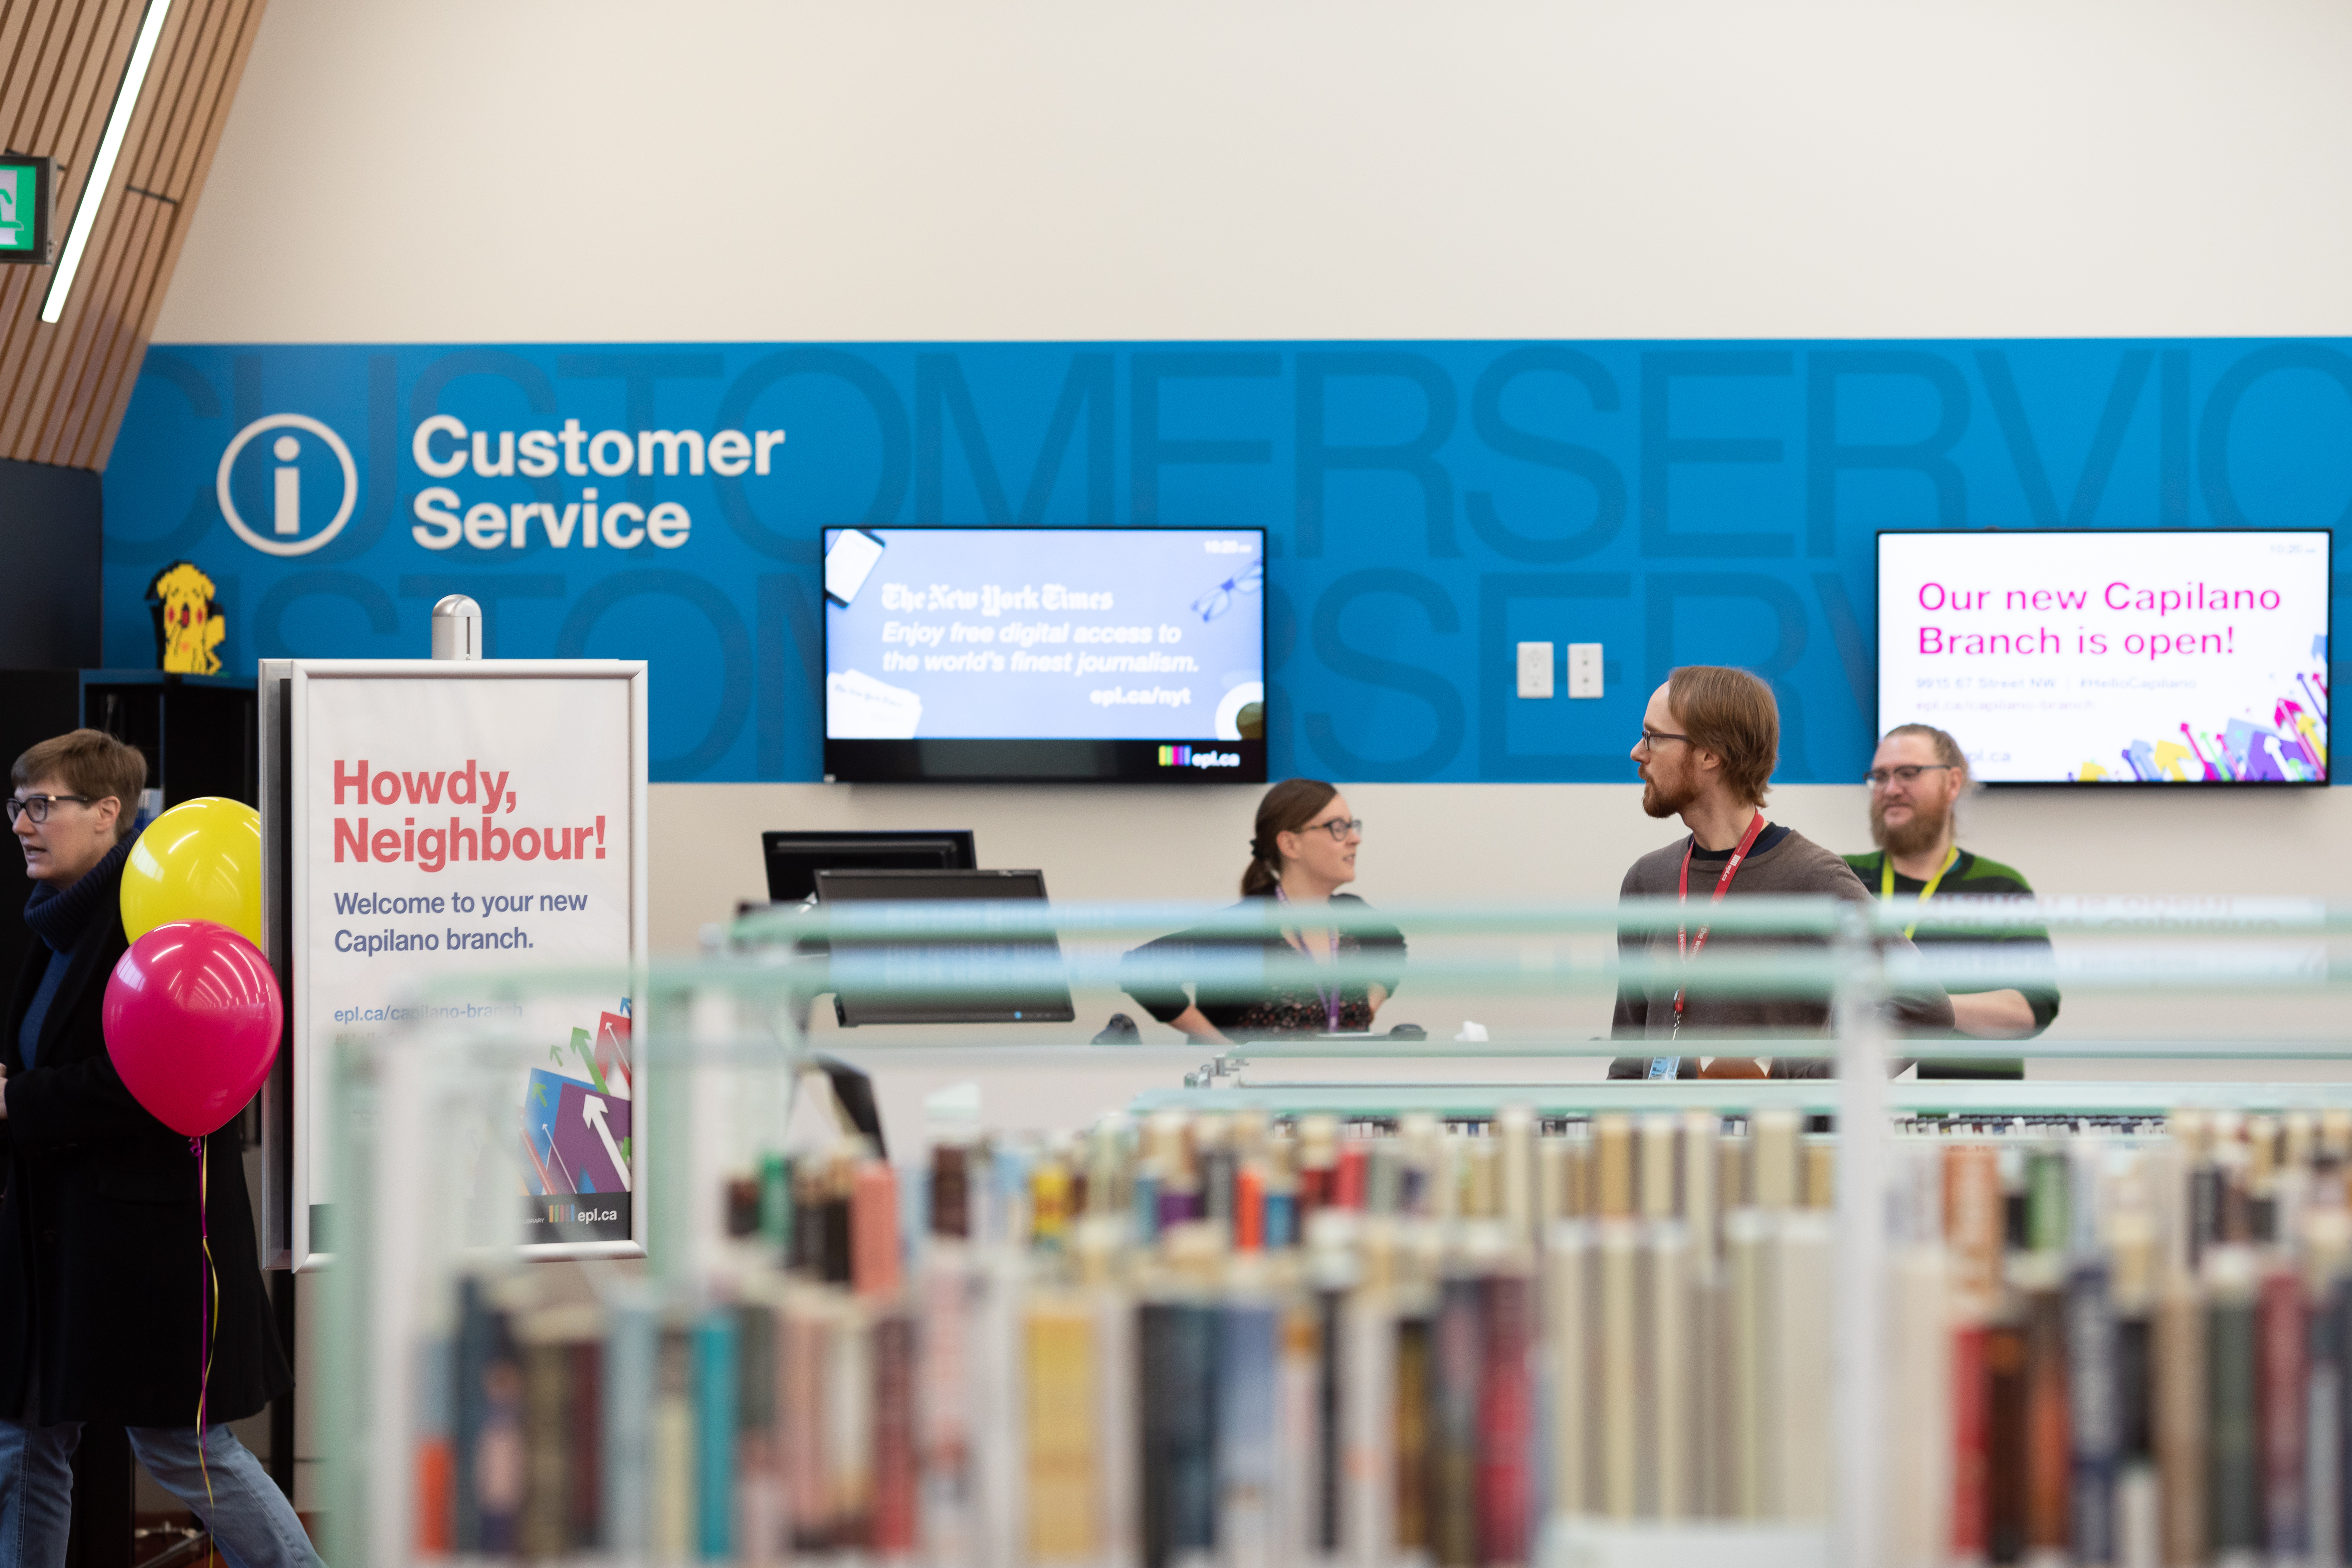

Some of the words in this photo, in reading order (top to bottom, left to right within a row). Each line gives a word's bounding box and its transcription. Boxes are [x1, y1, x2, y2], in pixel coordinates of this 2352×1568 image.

[413, 415, 785, 477] Customer
[413, 487, 691, 549] Service
[882, 583, 926, 613] The
[928, 584, 978, 611] New
[981, 585, 1039, 617] York
[1042, 584, 1113, 610] Times
[1919, 583, 1990, 610] Our
[2007, 590, 2087, 610] new
[2105, 582, 2280, 616] Capilano
[882, 621, 945, 647] Enjoy
[950, 622, 995, 643] free
[999, 622, 1069, 648] digital
[1073, 626, 1153, 643] access
[1159, 624, 1182, 643] to
[1920, 627, 2059, 654] Branch
[2079, 627, 2107, 654] is
[2125, 626, 2233, 660] open!
[883, 650, 919, 671] the
[924, 651, 1005, 672] world's
[1011, 651, 1073, 672] finest
[1075, 651, 1198, 677] journalism.
[1090, 686, 1190, 707] epl.ca/nyt
[1978, 677, 2024, 689] Street
[2031, 677, 2056, 688] NW
[1192, 751, 1240, 769] epl.ca
[1965, 748, 2011, 767] pl.ca
[334, 760, 516, 814] Howdy,
[334, 815, 606, 873] Neighbour!
[1722, 865, 1732, 881] epl.ca
[334, 892, 445, 915] Welcome
[451, 892, 475, 913] to
[482, 895, 534, 918] your
[540, 895, 588, 911] new
[335, 929, 439, 957] Capilano
[447, 927, 533, 950] branch.
[578, 1208, 617, 1224] epl.ca
